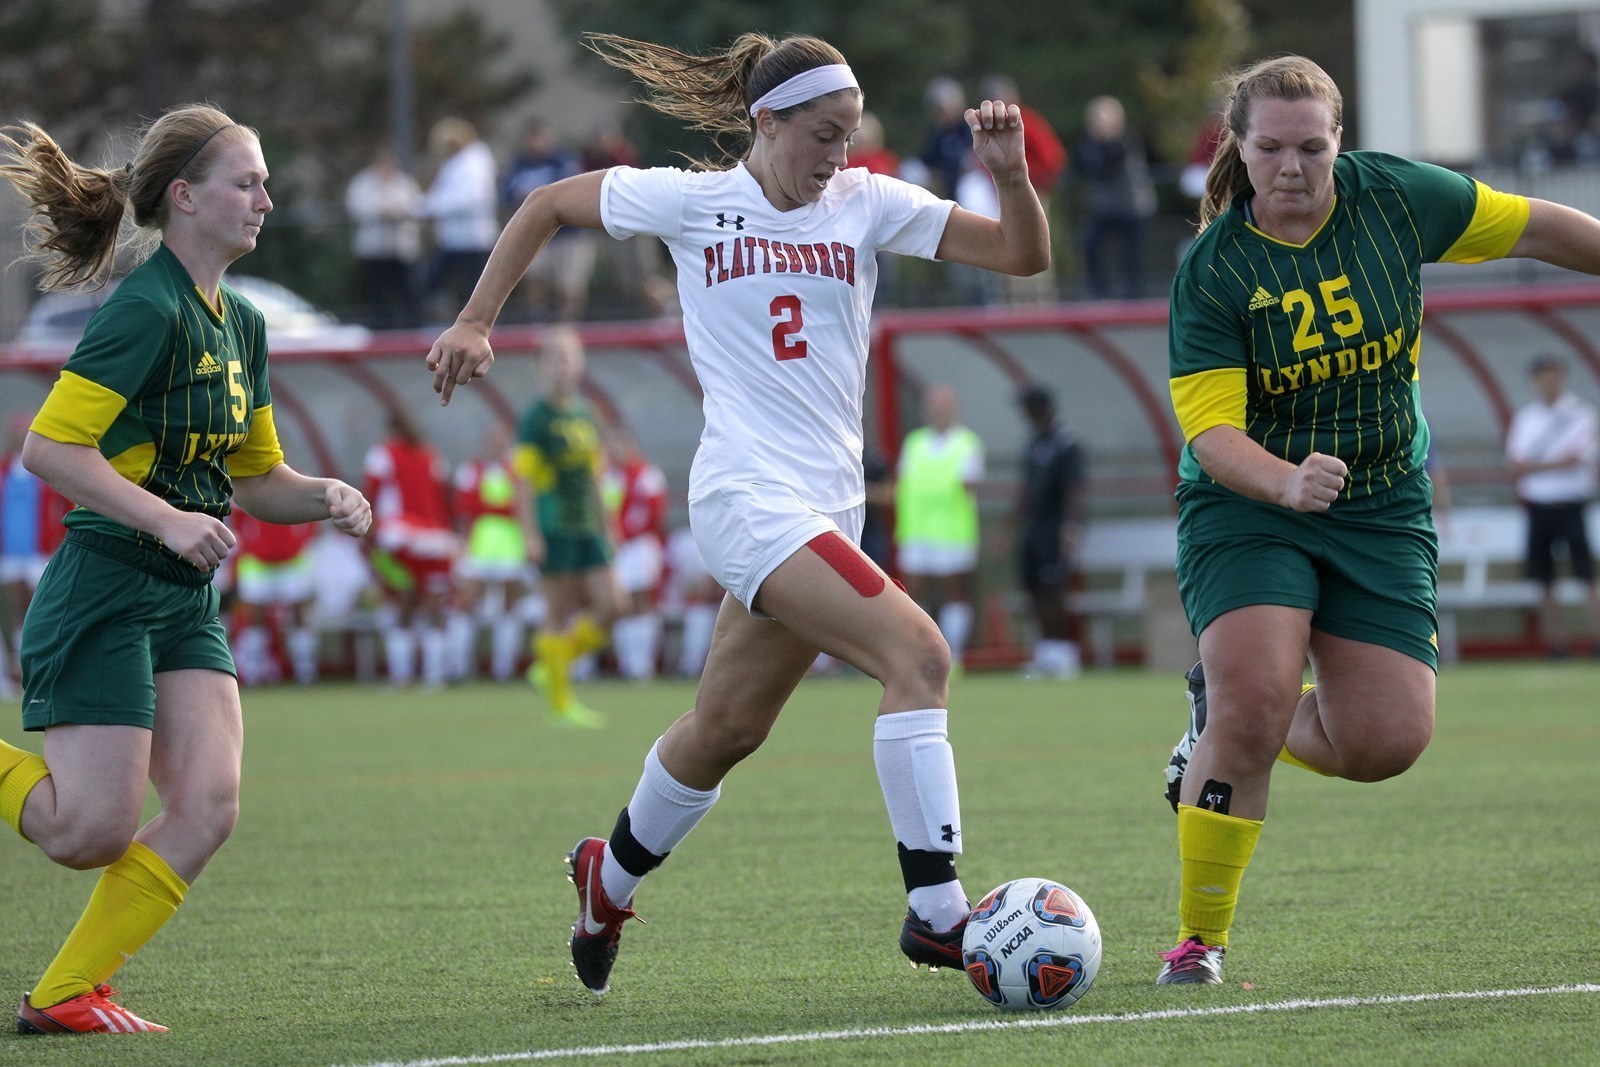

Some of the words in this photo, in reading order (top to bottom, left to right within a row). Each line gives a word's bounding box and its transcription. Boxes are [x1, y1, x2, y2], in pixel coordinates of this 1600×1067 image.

[703, 236, 856, 289] PLATTSBURGH
[1248, 296, 1280, 311] adidas
[1281, 274, 1364, 353] 25
[769, 294, 808, 361] 2
[195, 364, 222, 375] adidas
[1260, 327, 1403, 395] LYNDON
[227, 360, 247, 423] 5
[1206, 792, 1224, 804] KT
[983, 908, 1024, 944] Wilson
[1000, 925, 1035, 960] NCAA
